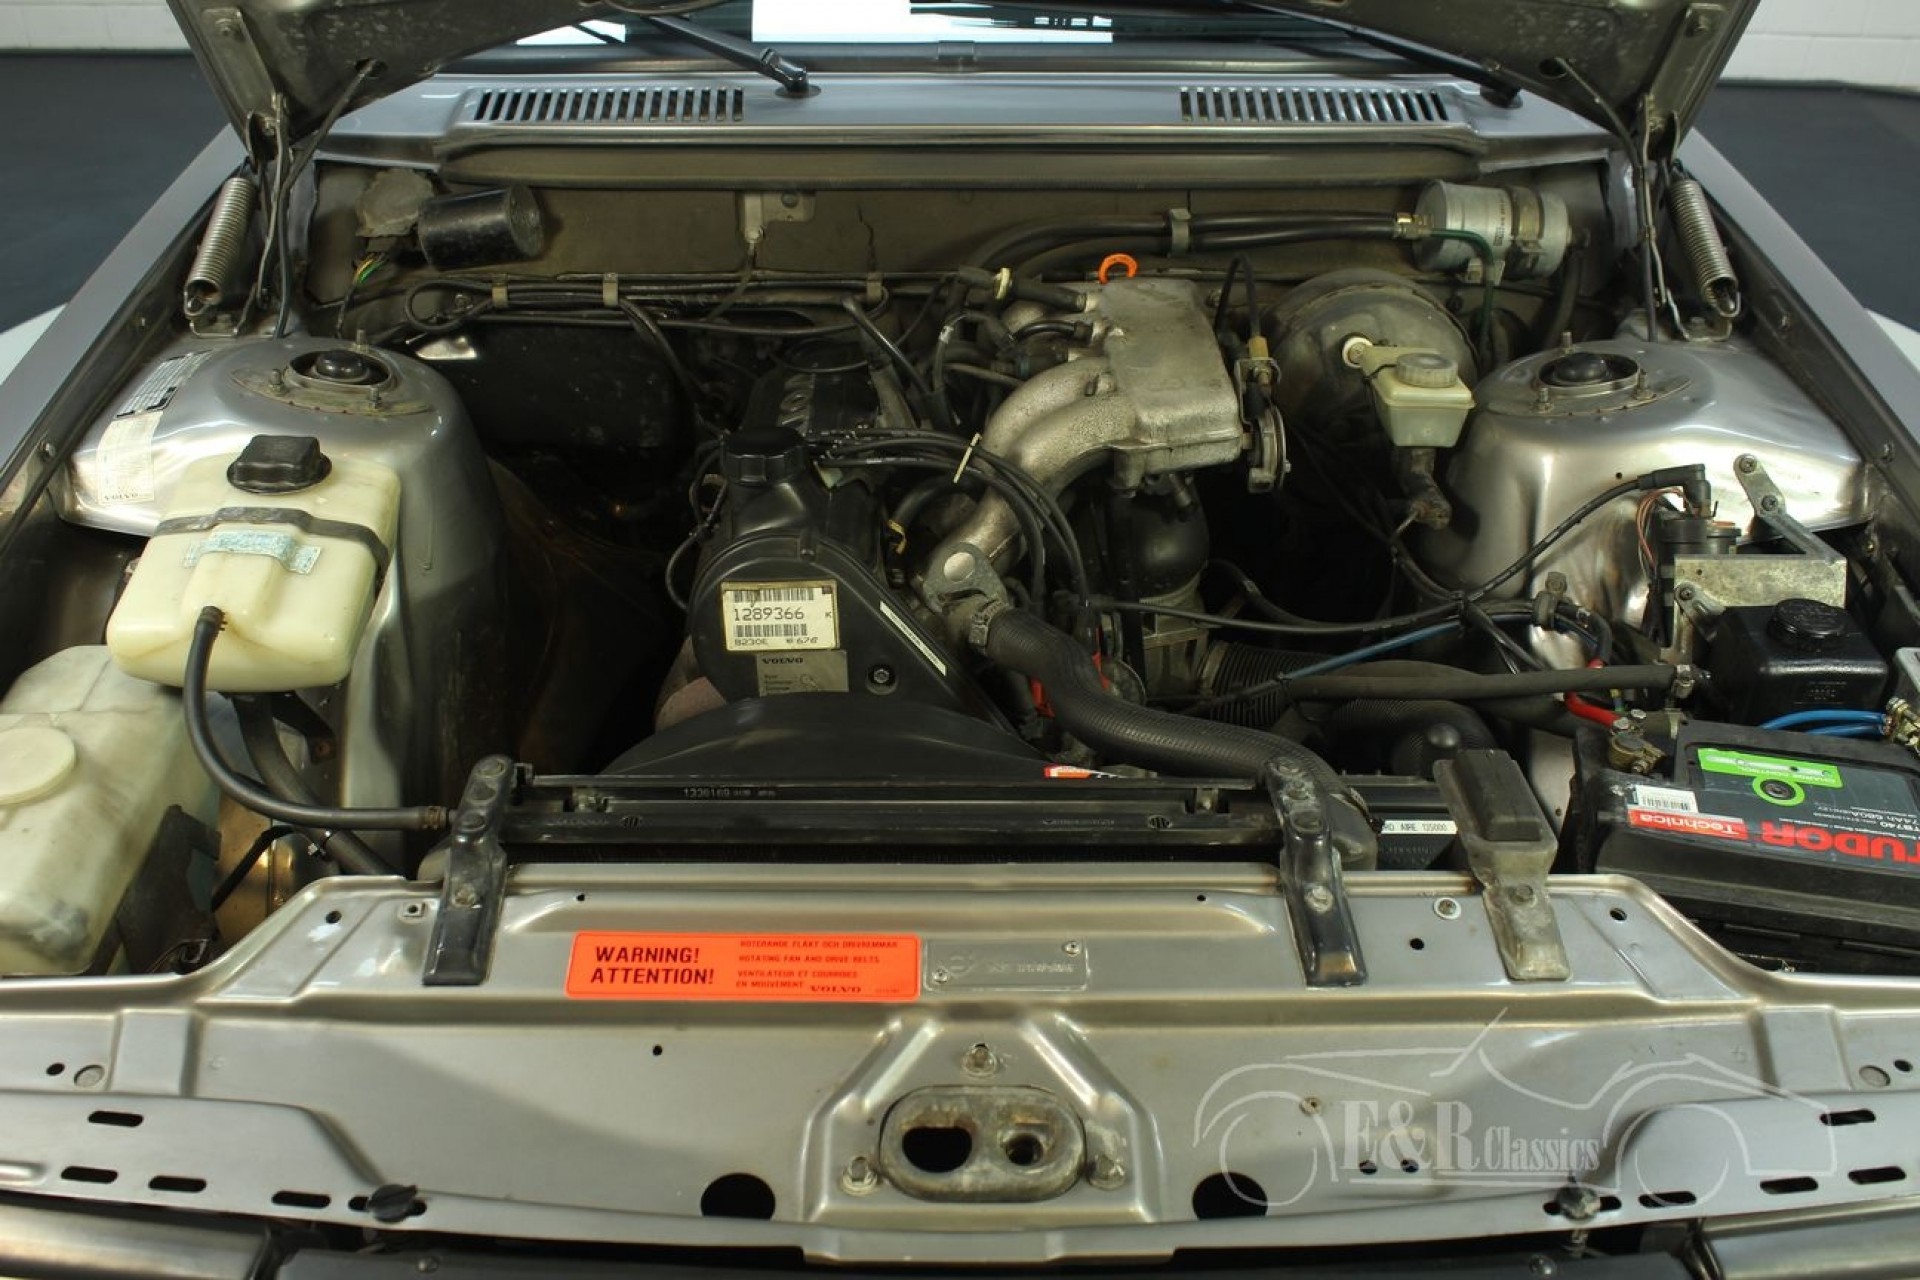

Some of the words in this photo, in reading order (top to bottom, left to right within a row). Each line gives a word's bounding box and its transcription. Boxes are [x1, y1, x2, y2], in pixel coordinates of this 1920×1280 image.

[734, 607, 805, 621] 1289366
[762, 657, 804, 665] VOLVO
[1639, 813, 1740, 836] Technica
[595, 946, 699, 964] WARNING!
[739, 955, 780, 963] ROTATING
[784, 955, 801, 963] FAN
[853, 956, 880, 964] BELTS
[590, 967, 714, 985] ATTENTION!
[737, 970, 795, 978] VENTILATEUR
[798, 970, 808, 978] ET
[751, 981, 804, 989] MOUVEMENT
[811, 985, 862, 993] VOLVO
